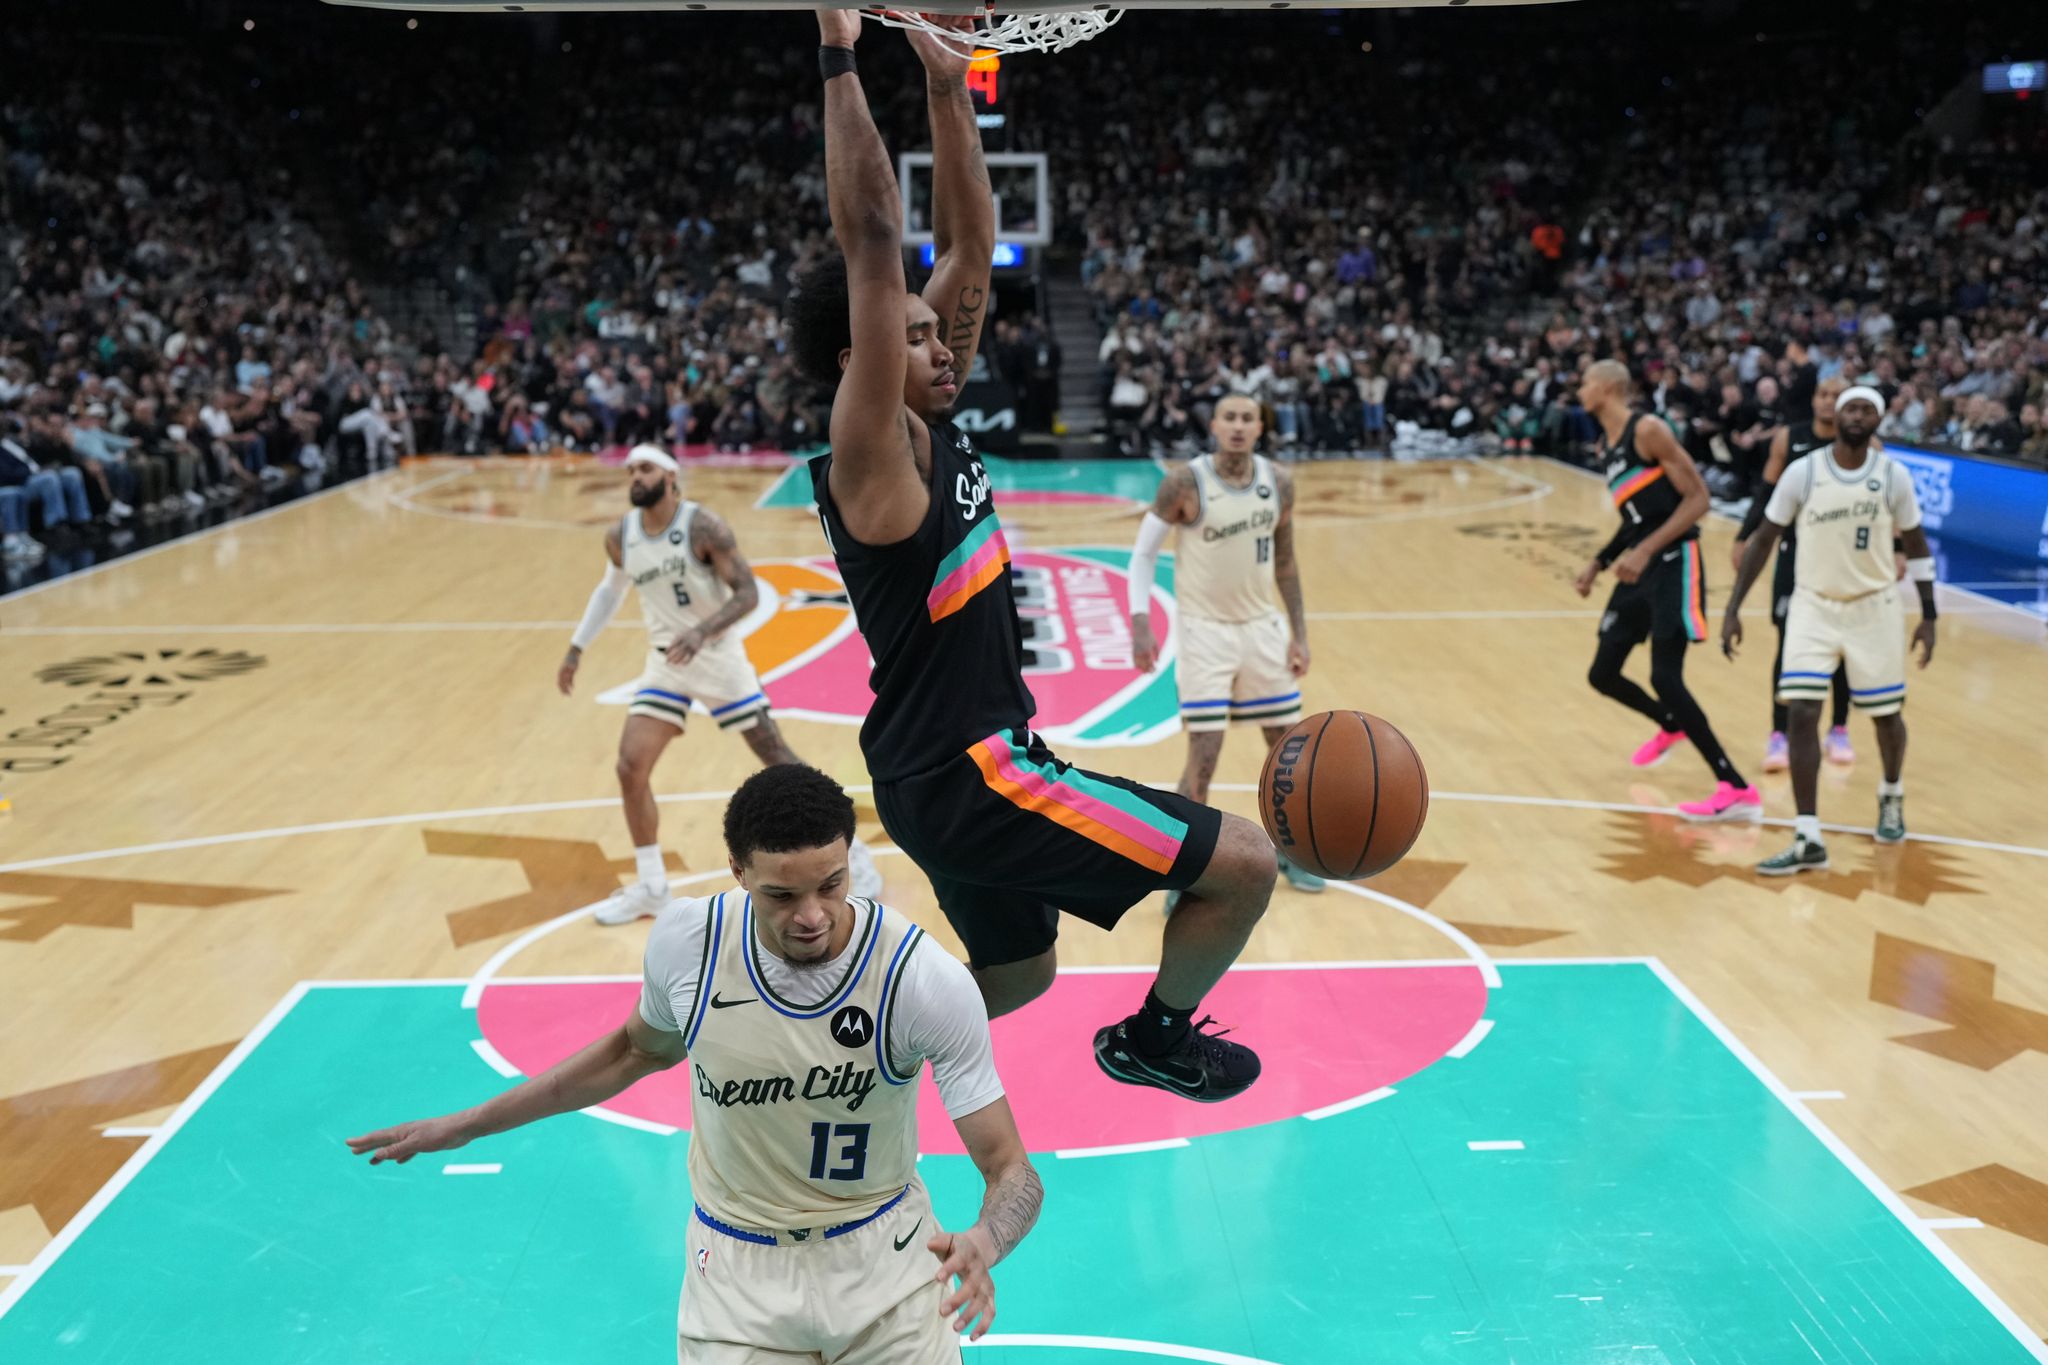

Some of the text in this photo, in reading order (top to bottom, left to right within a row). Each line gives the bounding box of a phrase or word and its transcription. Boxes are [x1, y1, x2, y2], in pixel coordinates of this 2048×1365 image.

[1855, 527, 1870, 551] 9
[672, 582, 691, 607] 5
[1272, 734, 1311, 847] Wilson
[801, 1061, 876, 1112] City
[809, 1122, 871, 1181] 13
